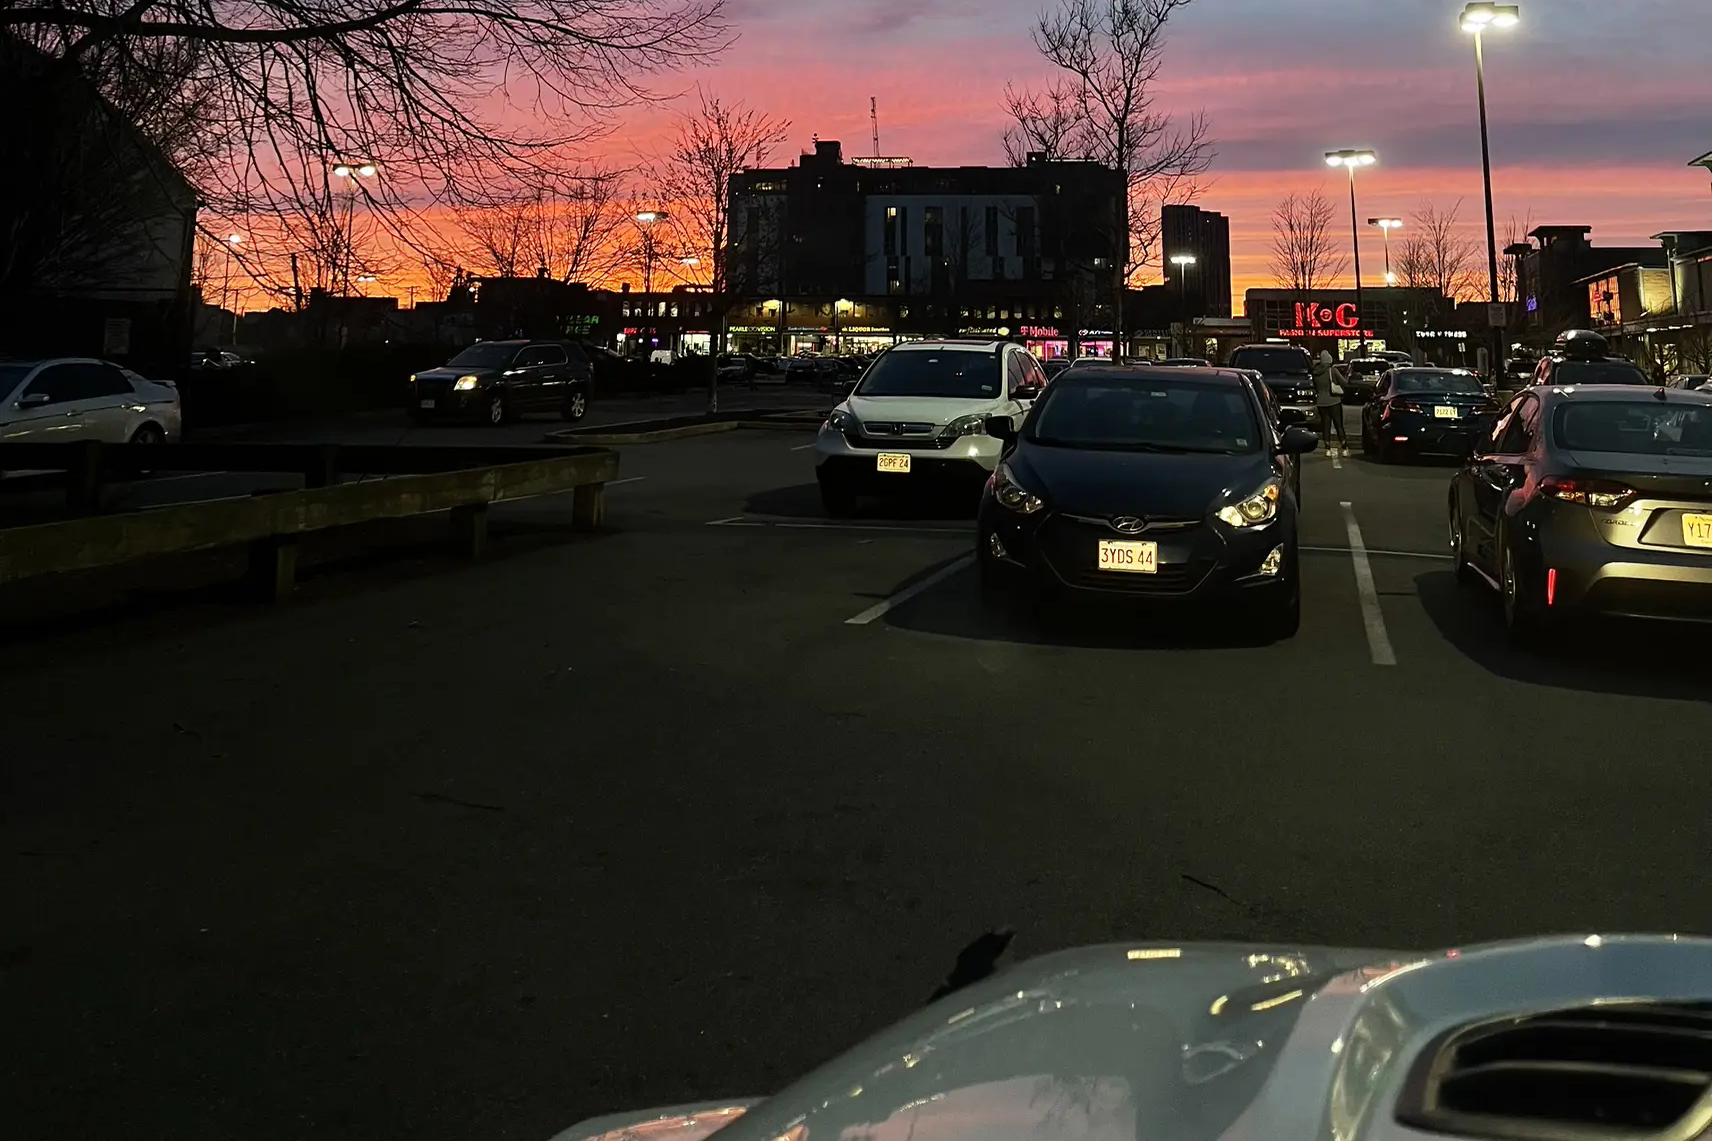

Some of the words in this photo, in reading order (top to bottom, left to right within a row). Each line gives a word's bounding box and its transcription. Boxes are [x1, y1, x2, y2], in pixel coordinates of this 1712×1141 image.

[1029, 326, 1059, 337] Mobile
[899, 458, 909, 468] 24
[1101, 547, 1134, 564] 3YDS
[1137, 550, 1153, 565] 44
